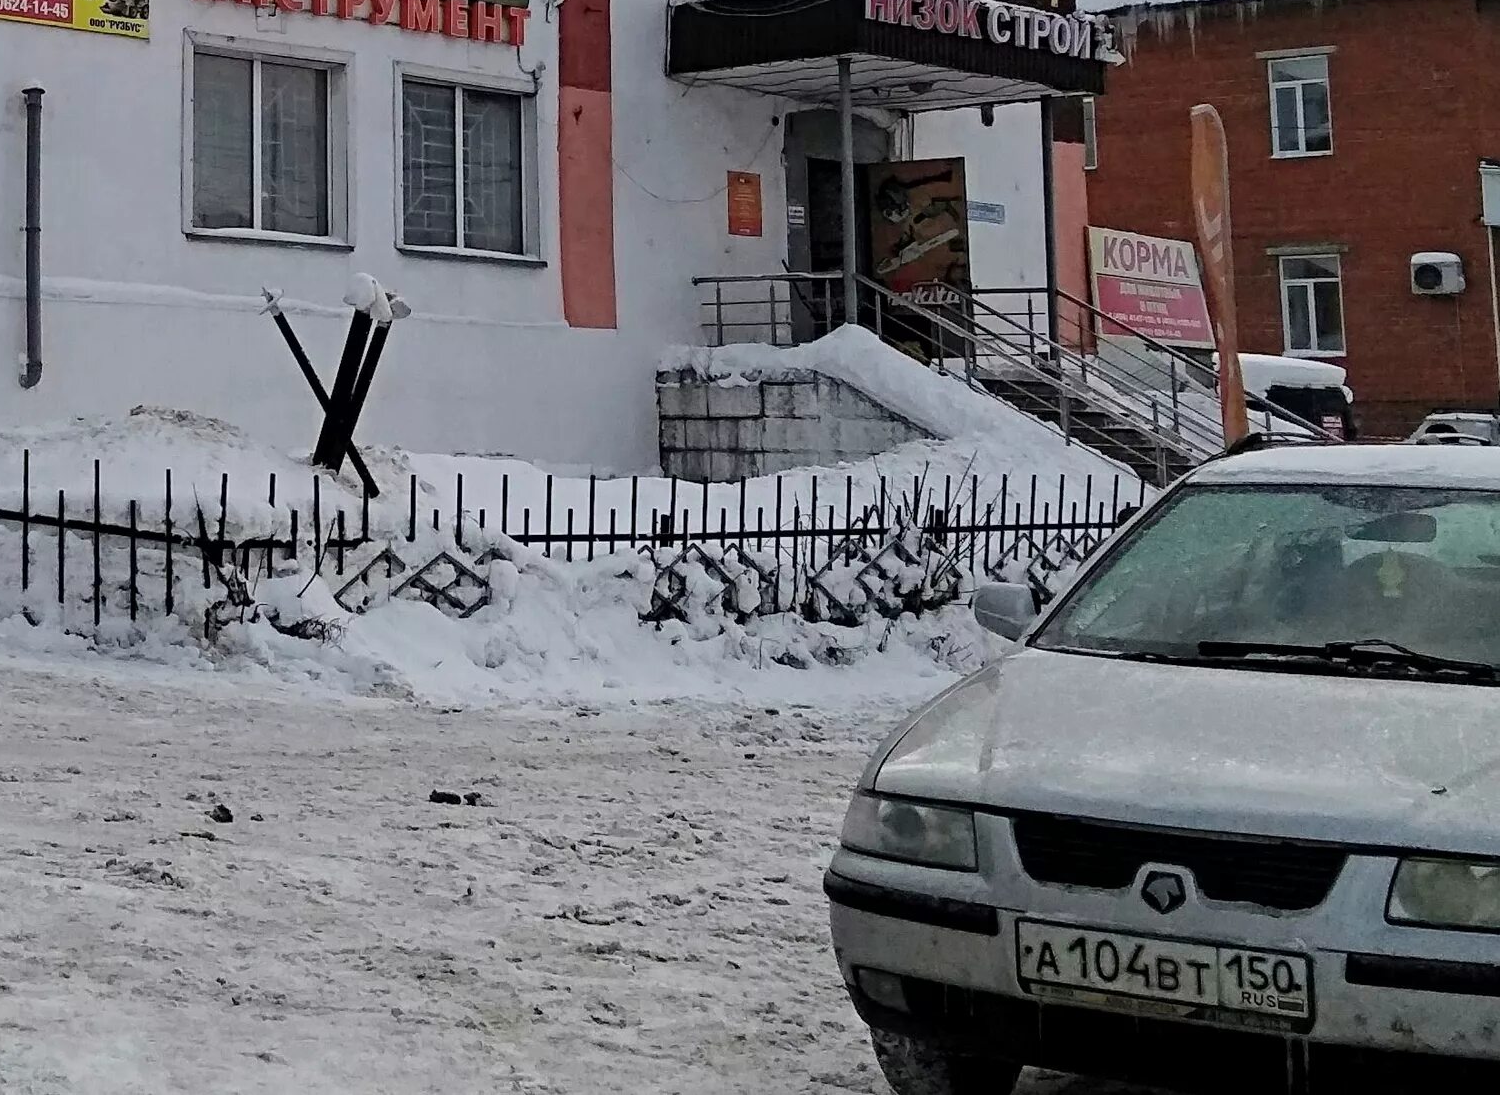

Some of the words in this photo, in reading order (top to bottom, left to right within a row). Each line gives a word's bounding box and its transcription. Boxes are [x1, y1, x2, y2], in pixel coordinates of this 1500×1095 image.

[1102, 235, 1191, 279] КОРМА
[1225, 955, 1296, 994] 150
[1240, 991, 1278, 1009] RUS
